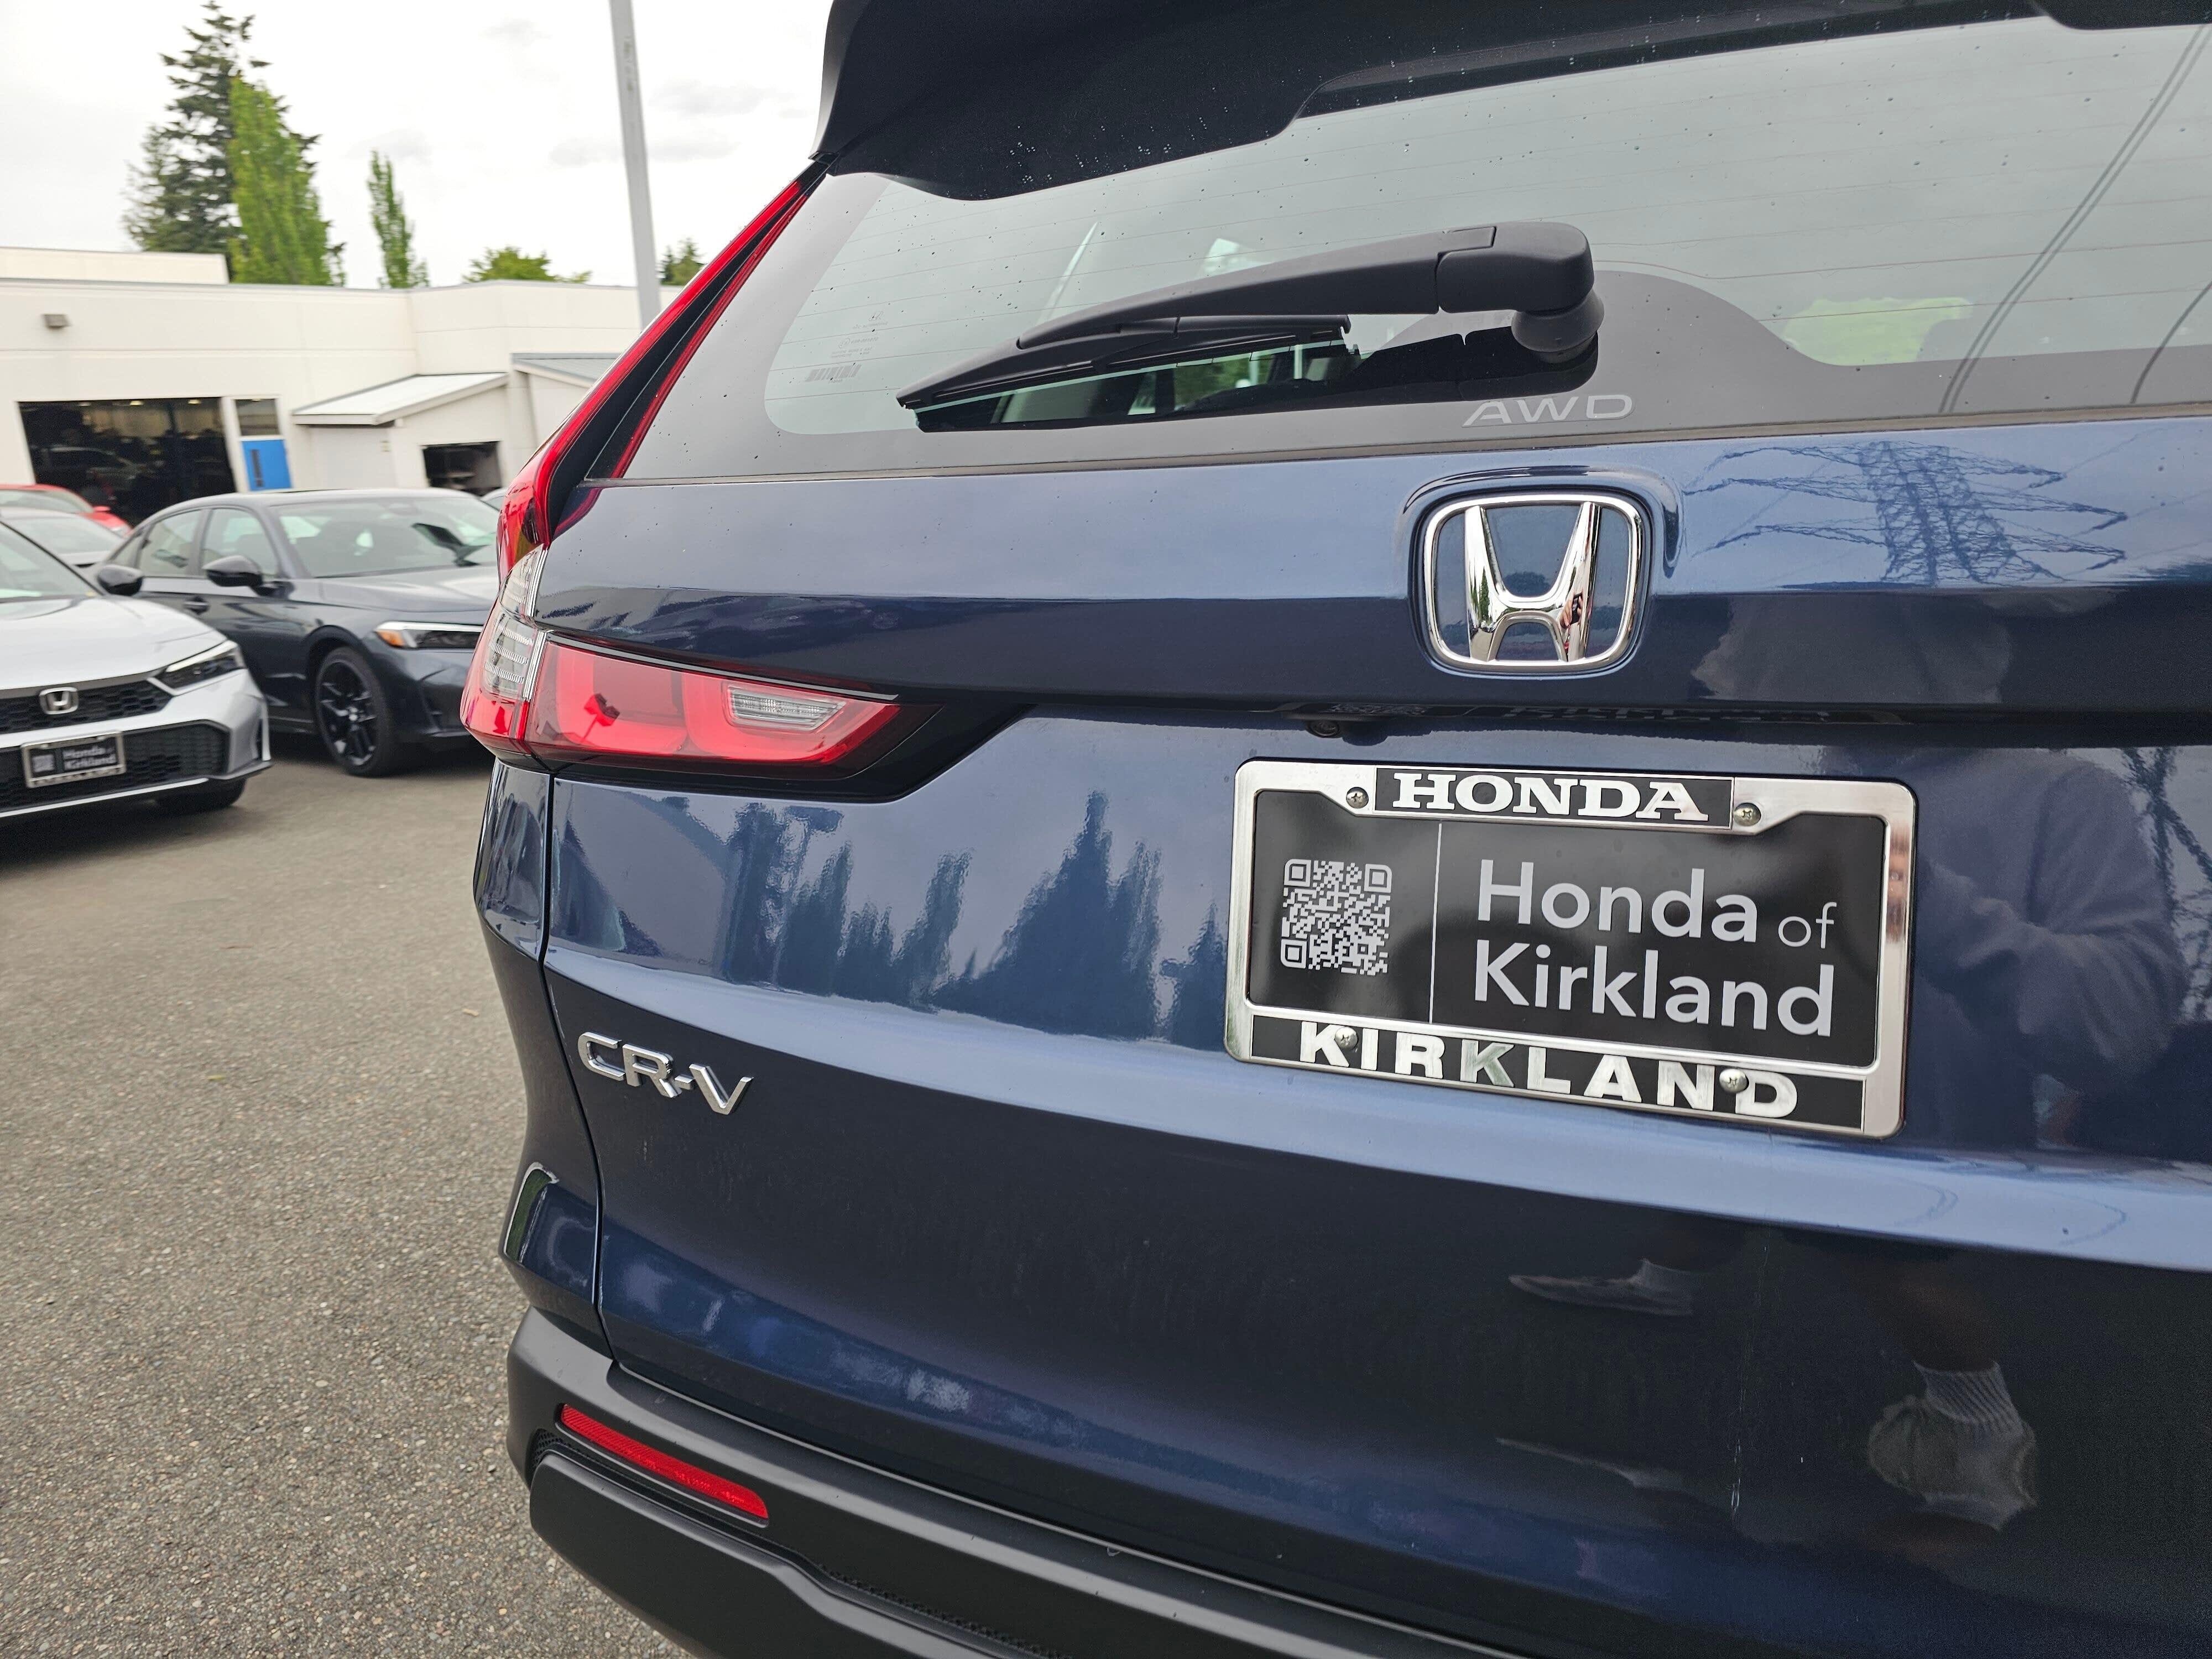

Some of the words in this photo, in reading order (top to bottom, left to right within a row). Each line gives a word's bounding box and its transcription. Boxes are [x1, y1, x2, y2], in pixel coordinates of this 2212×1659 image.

[1462, 394, 1633, 427] AWD
[1392, 773, 1709, 821] HONDA
[1478, 859, 1759, 943] Honda
[1777, 901, 1838, 950] of
[1474, 939, 1835, 1037] Kirkland
[578, 1032, 754, 1115] CR-V
[1300, 1021, 1798, 1118] KIRKLAND
